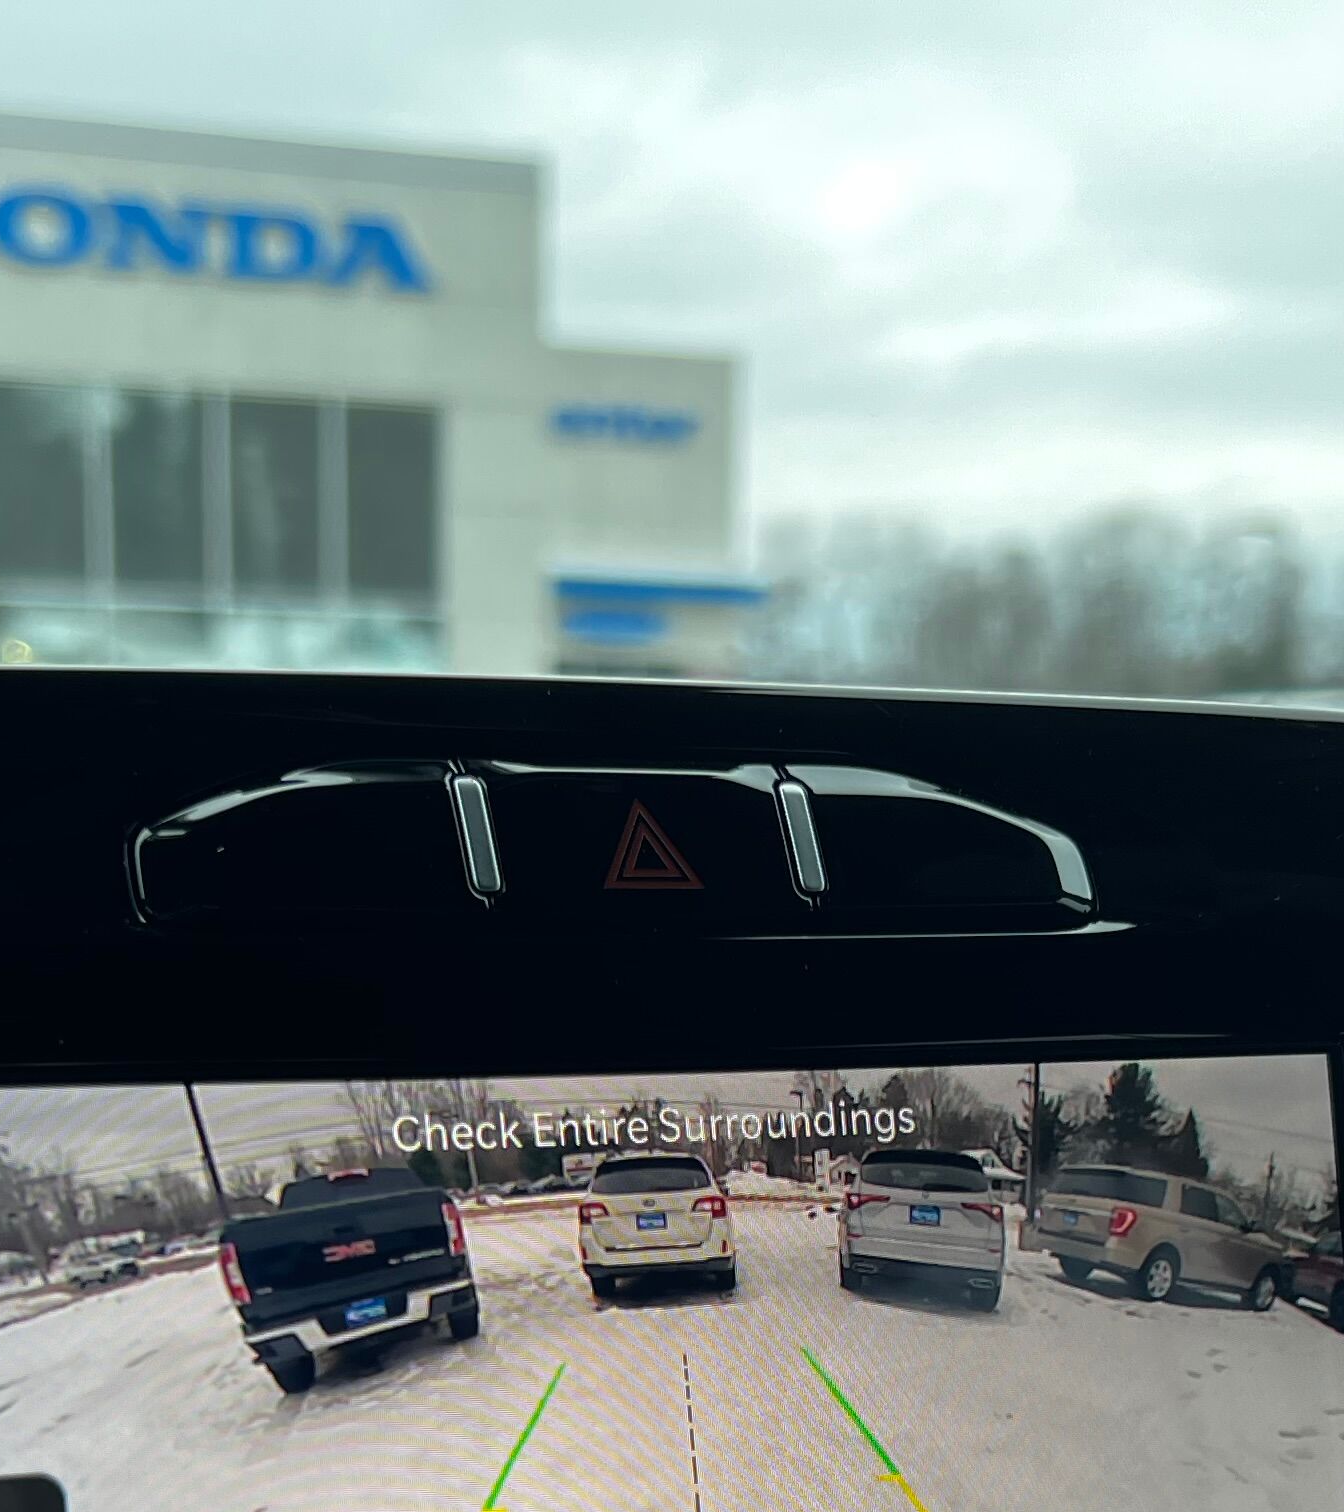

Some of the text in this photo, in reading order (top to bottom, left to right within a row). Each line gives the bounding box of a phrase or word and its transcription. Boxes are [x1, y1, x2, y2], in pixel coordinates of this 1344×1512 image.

[391, 1099, 916, 1154] Check Entire Surroundings
